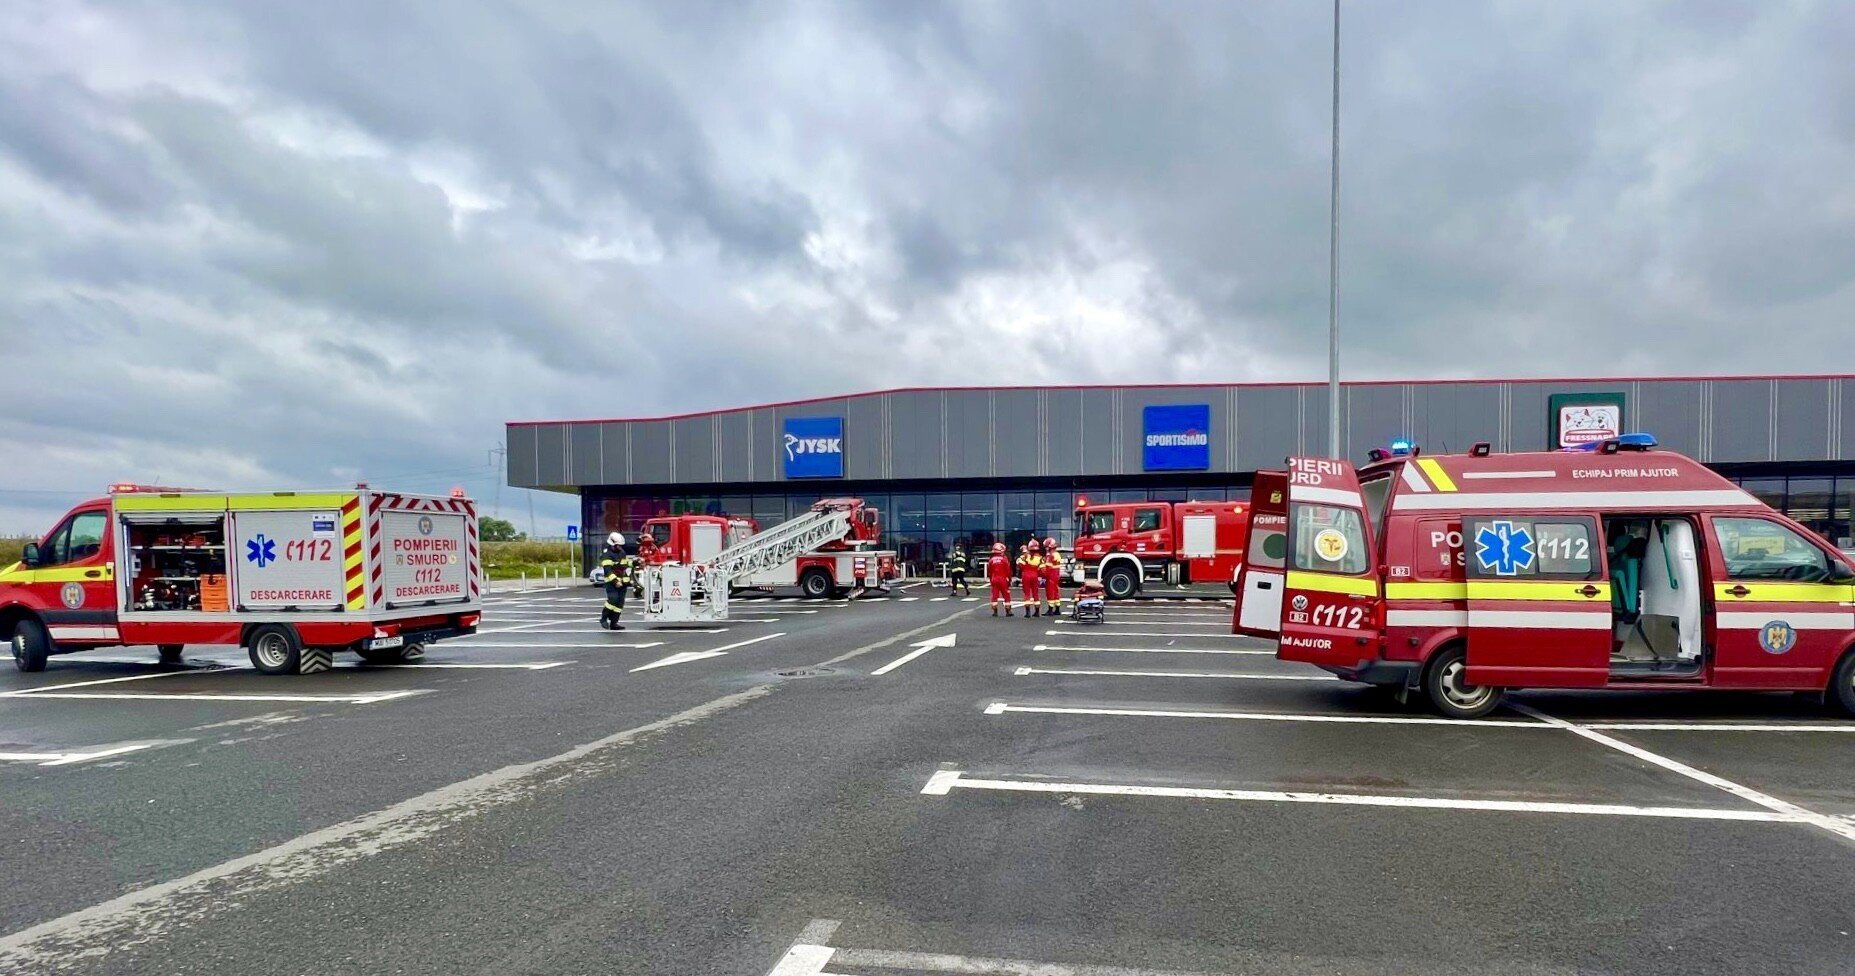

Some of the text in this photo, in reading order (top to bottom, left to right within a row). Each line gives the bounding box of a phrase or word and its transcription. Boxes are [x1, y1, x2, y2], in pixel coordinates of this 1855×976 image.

[796, 438, 841, 454] JYSK
[1572, 468, 1679, 479] ECHIPAJ PRIM AJUTOR
[295, 539, 332, 561] 112
[394, 539, 457, 551] POMPIERII
[1547, 537, 1589, 560] 112
[407, 554, 448, 566] SMURD
[421, 568, 441, 583] 112
[250, 590, 332, 600] DESCARCERARE
[396, 584, 461, 597] DESCARCERARE
[1323, 604, 1363, 630] 112
